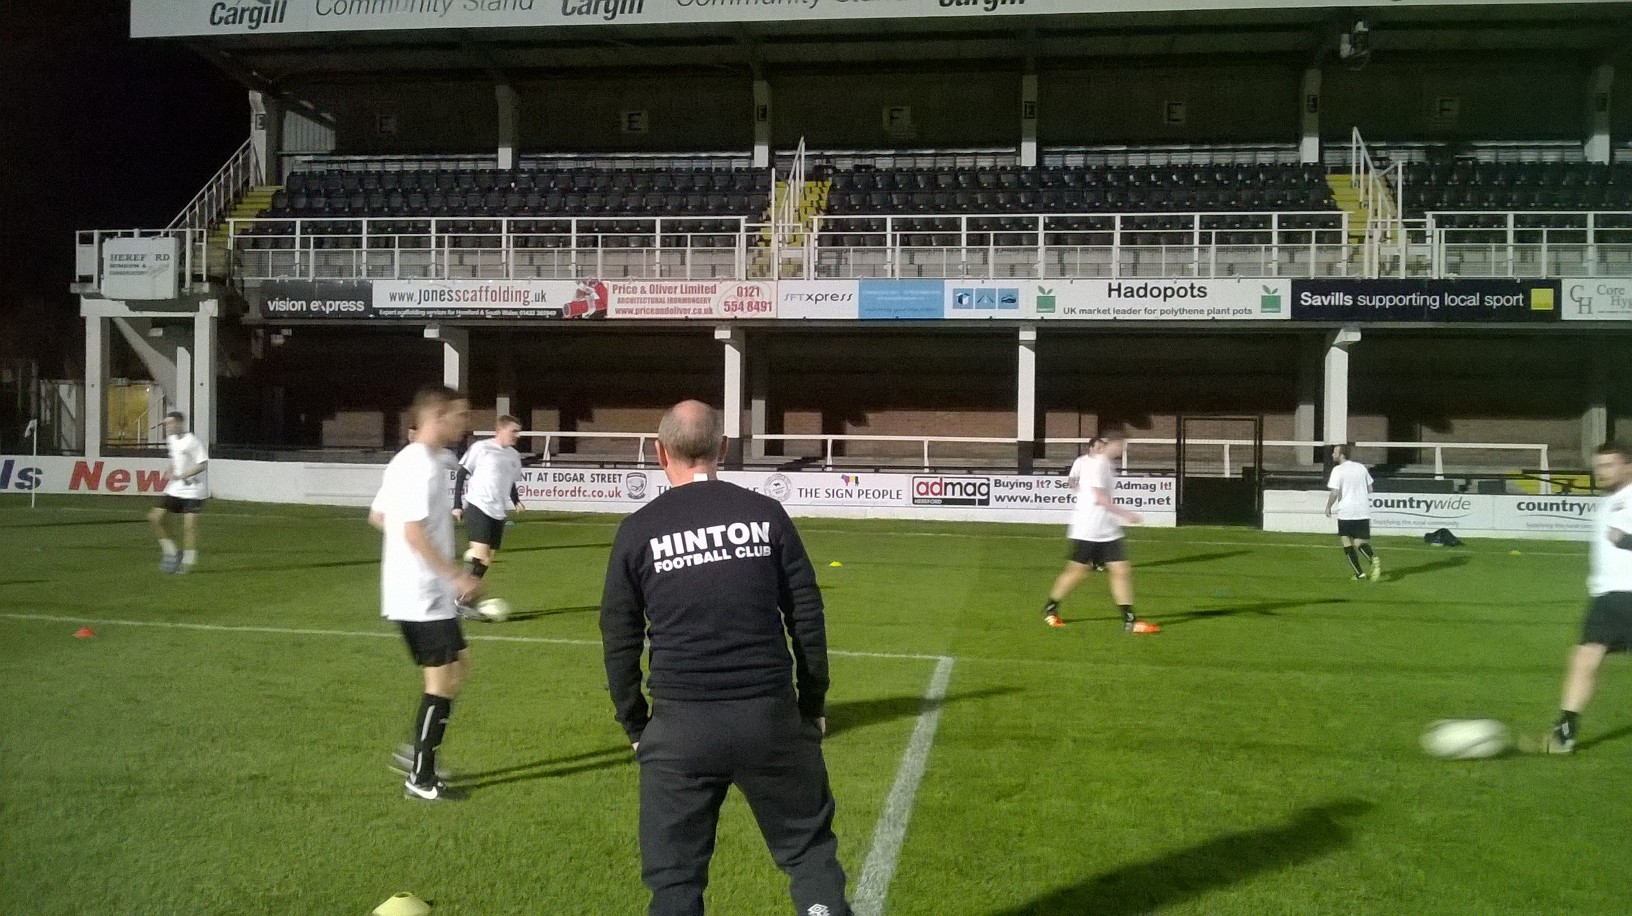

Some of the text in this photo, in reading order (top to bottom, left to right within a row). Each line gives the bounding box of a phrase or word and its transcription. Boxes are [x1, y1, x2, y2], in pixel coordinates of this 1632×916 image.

[209, 0, 288, 30] Cargill
[316, 0, 454, 17] Community
[627, 112, 642, 131] E
[612, 284, 717, 294] Price & Oliver Limited
[736, 286, 760, 298] 0121
[1107, 281, 1208, 302] Hadopots
[1596, 284, 1626, 296] Core
[267, 297, 365, 317] vision express
[723, 301, 773, 313] 554 8491
[1300, 291, 1525, 310] Savills supporting local sport
[1063, 306, 1253, 317] UK market leader for polythene plant pots
[536, 472, 549, 482] AT
[552, 473, 585, 483] EDGAR
[590, 474, 623, 484] STREET
[993, 478, 1033, 490] Buying
[1036, 479, 1051, 490] It?
[1114, 481, 1157, 492] Admag
[1160, 482, 1172, 491] It!
[797, 487, 821, 499] THE
[824, 488, 853, 500] SIGN
[857, 488, 903, 501] PEOPLE
[649, 521, 771, 560] HINTON
[653, 545, 772, 574] FOOTBALL CLUB
